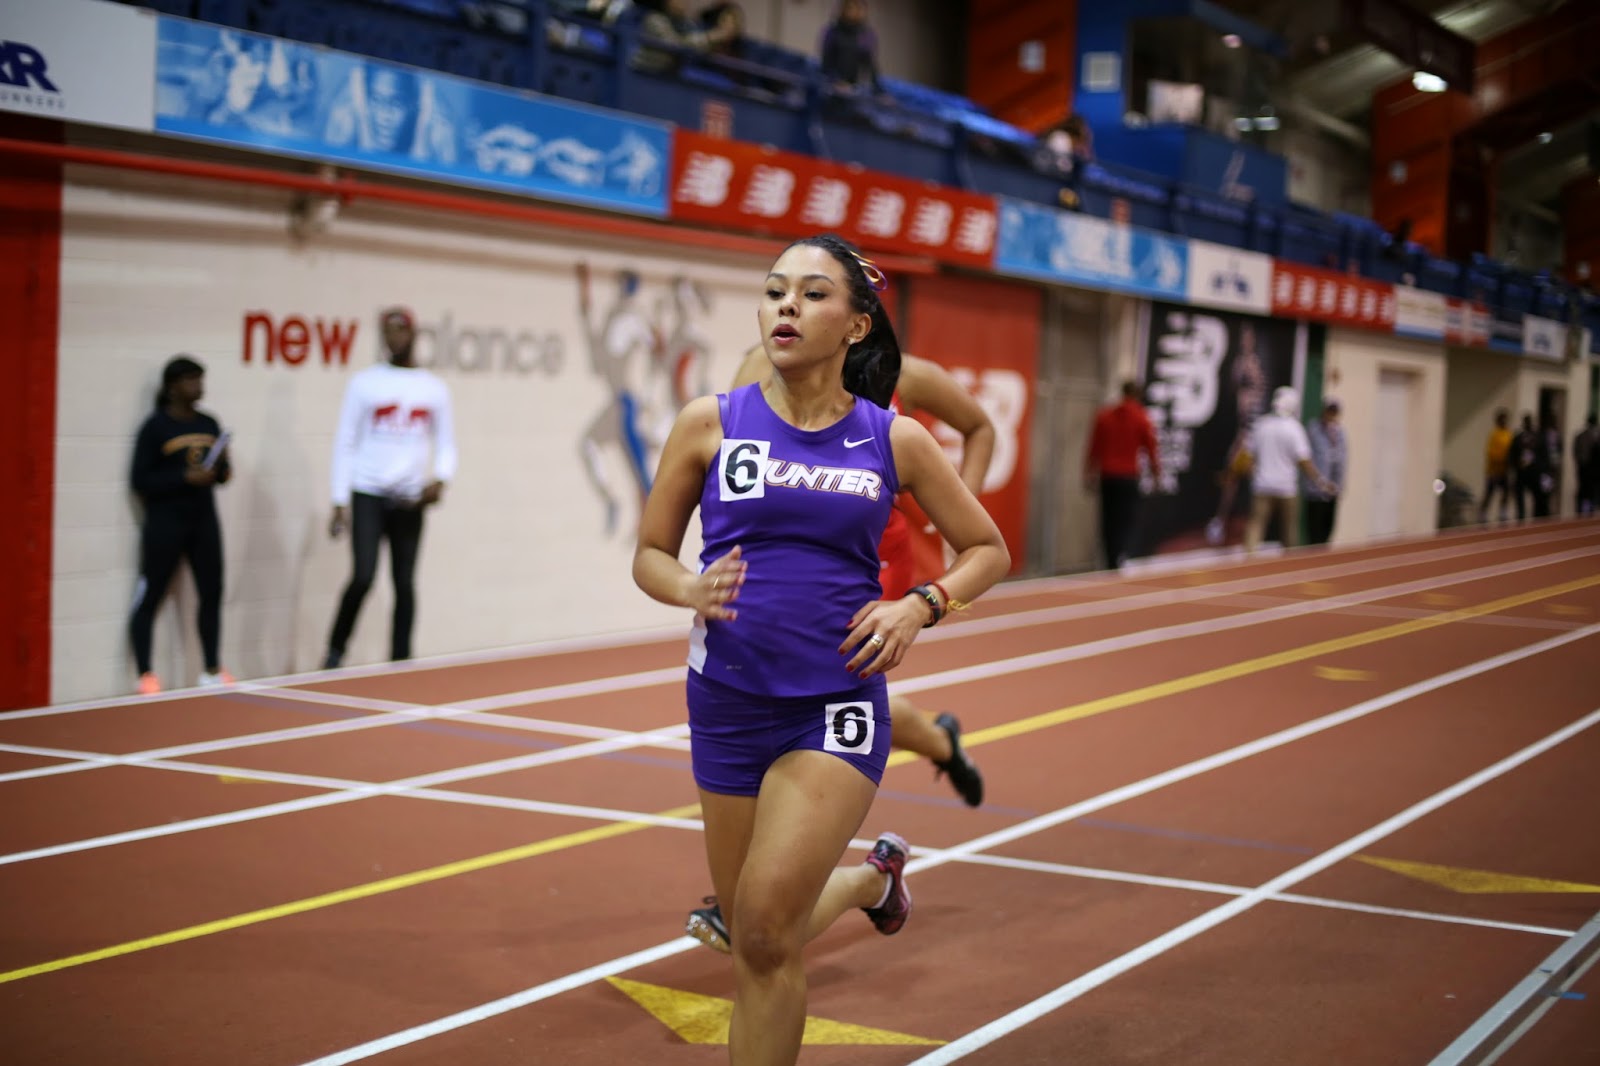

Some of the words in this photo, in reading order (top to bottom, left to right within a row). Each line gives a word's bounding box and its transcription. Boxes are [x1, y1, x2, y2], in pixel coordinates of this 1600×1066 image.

[242, 310, 358, 367] new
[380, 310, 566, 375] alance
[725, 443, 760, 495] 6
[764, 458, 882, 501] UNTER
[832, 705, 868, 748] 6
